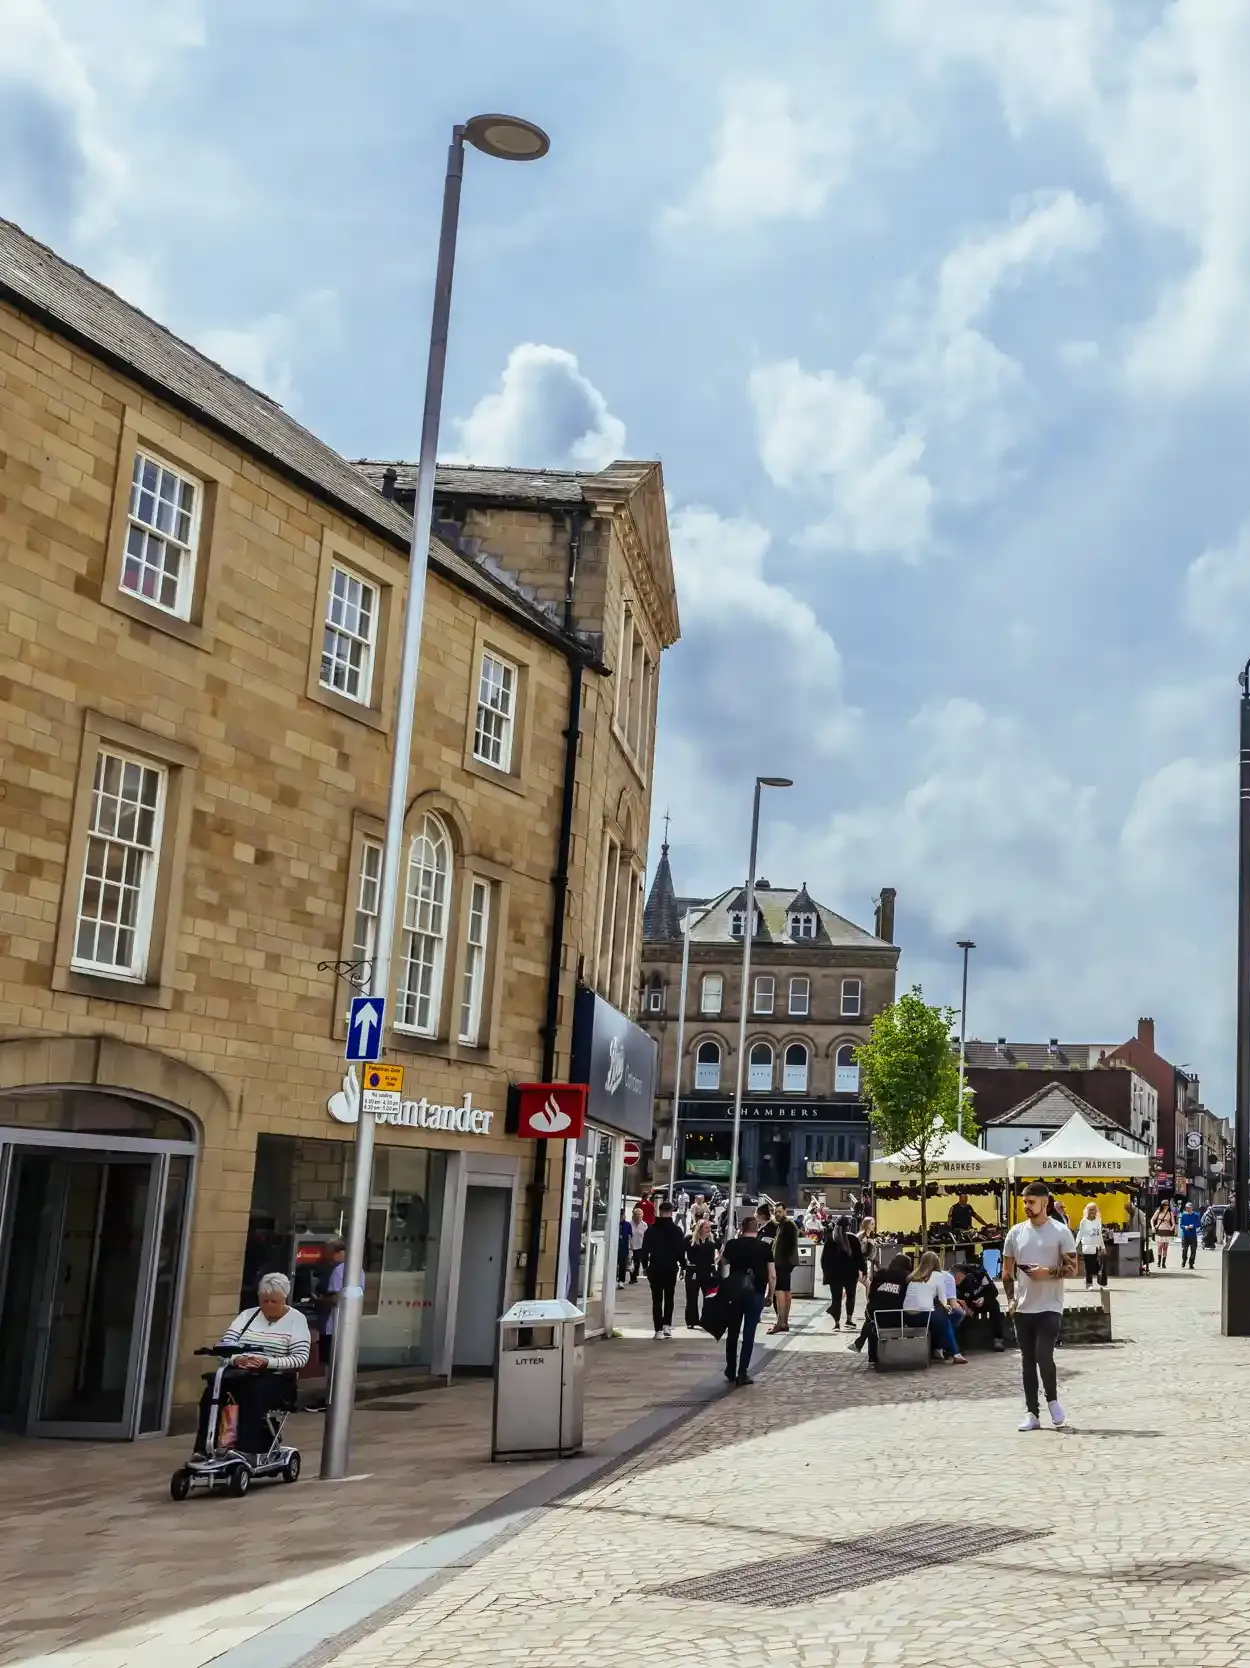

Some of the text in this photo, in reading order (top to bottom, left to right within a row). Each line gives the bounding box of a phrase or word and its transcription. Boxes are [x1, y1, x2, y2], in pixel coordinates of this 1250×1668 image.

[727, 1107, 819, 1117] CHAMBERS
[944, 1162, 981, 1172] MARKETS
[1042, 1161, 1122, 1170] BARNSLEY MARKETS
